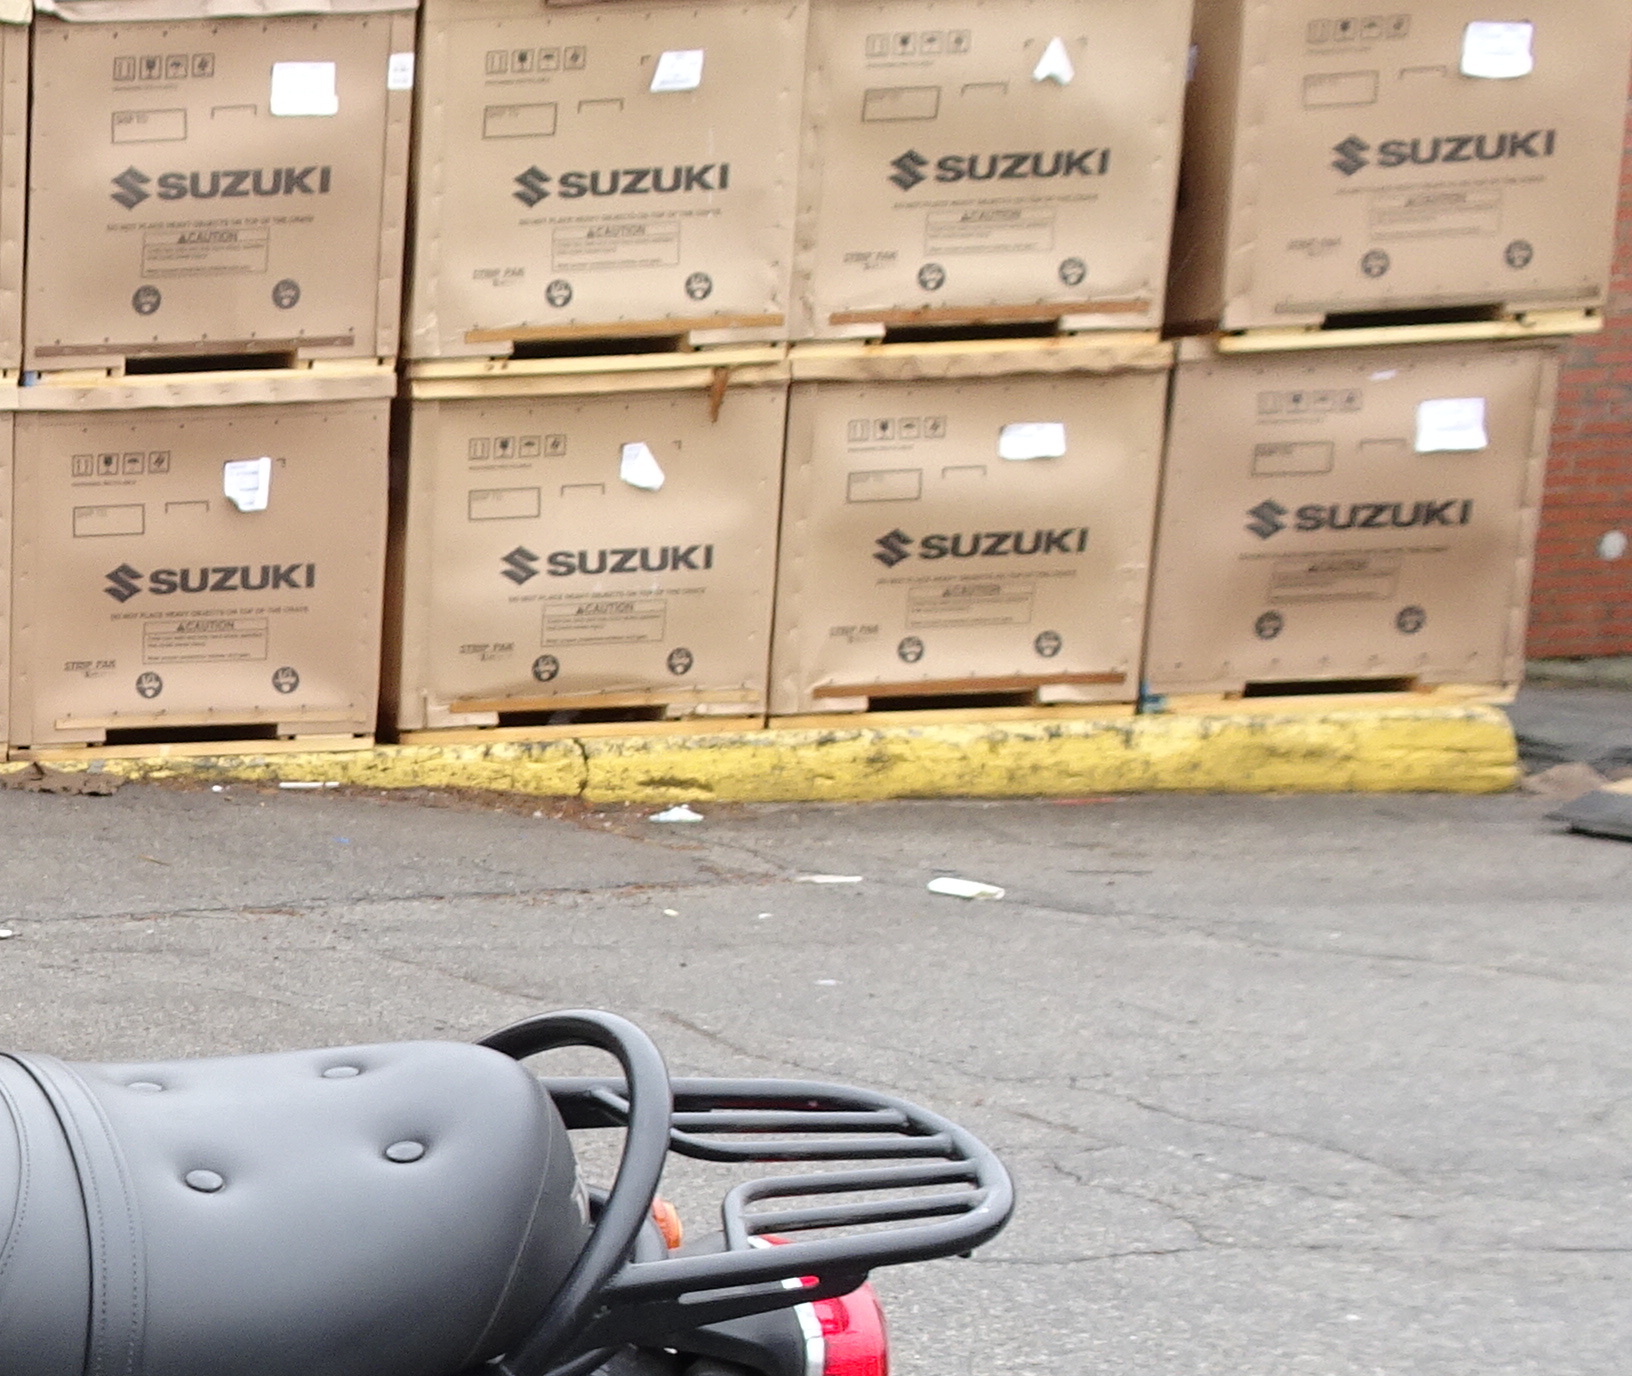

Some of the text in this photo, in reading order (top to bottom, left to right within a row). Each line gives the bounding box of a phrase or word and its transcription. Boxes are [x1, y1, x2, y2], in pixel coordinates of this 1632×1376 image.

[1378, 130, 1556, 167] SUZUKI
[558, 163, 729, 198] SUZUKI
[936, 149, 1110, 182] SUZUKI
[157, 166, 332, 200] SUZUKI
[1295, 499, 1472, 531] SUZUKI
[547, 544, 714, 577] SUZUKI
[919, 528, 1088, 560] SUZUKI
[148, 563, 316, 596] SUZUKI
[184, 620, 235, 632] CAUTION
